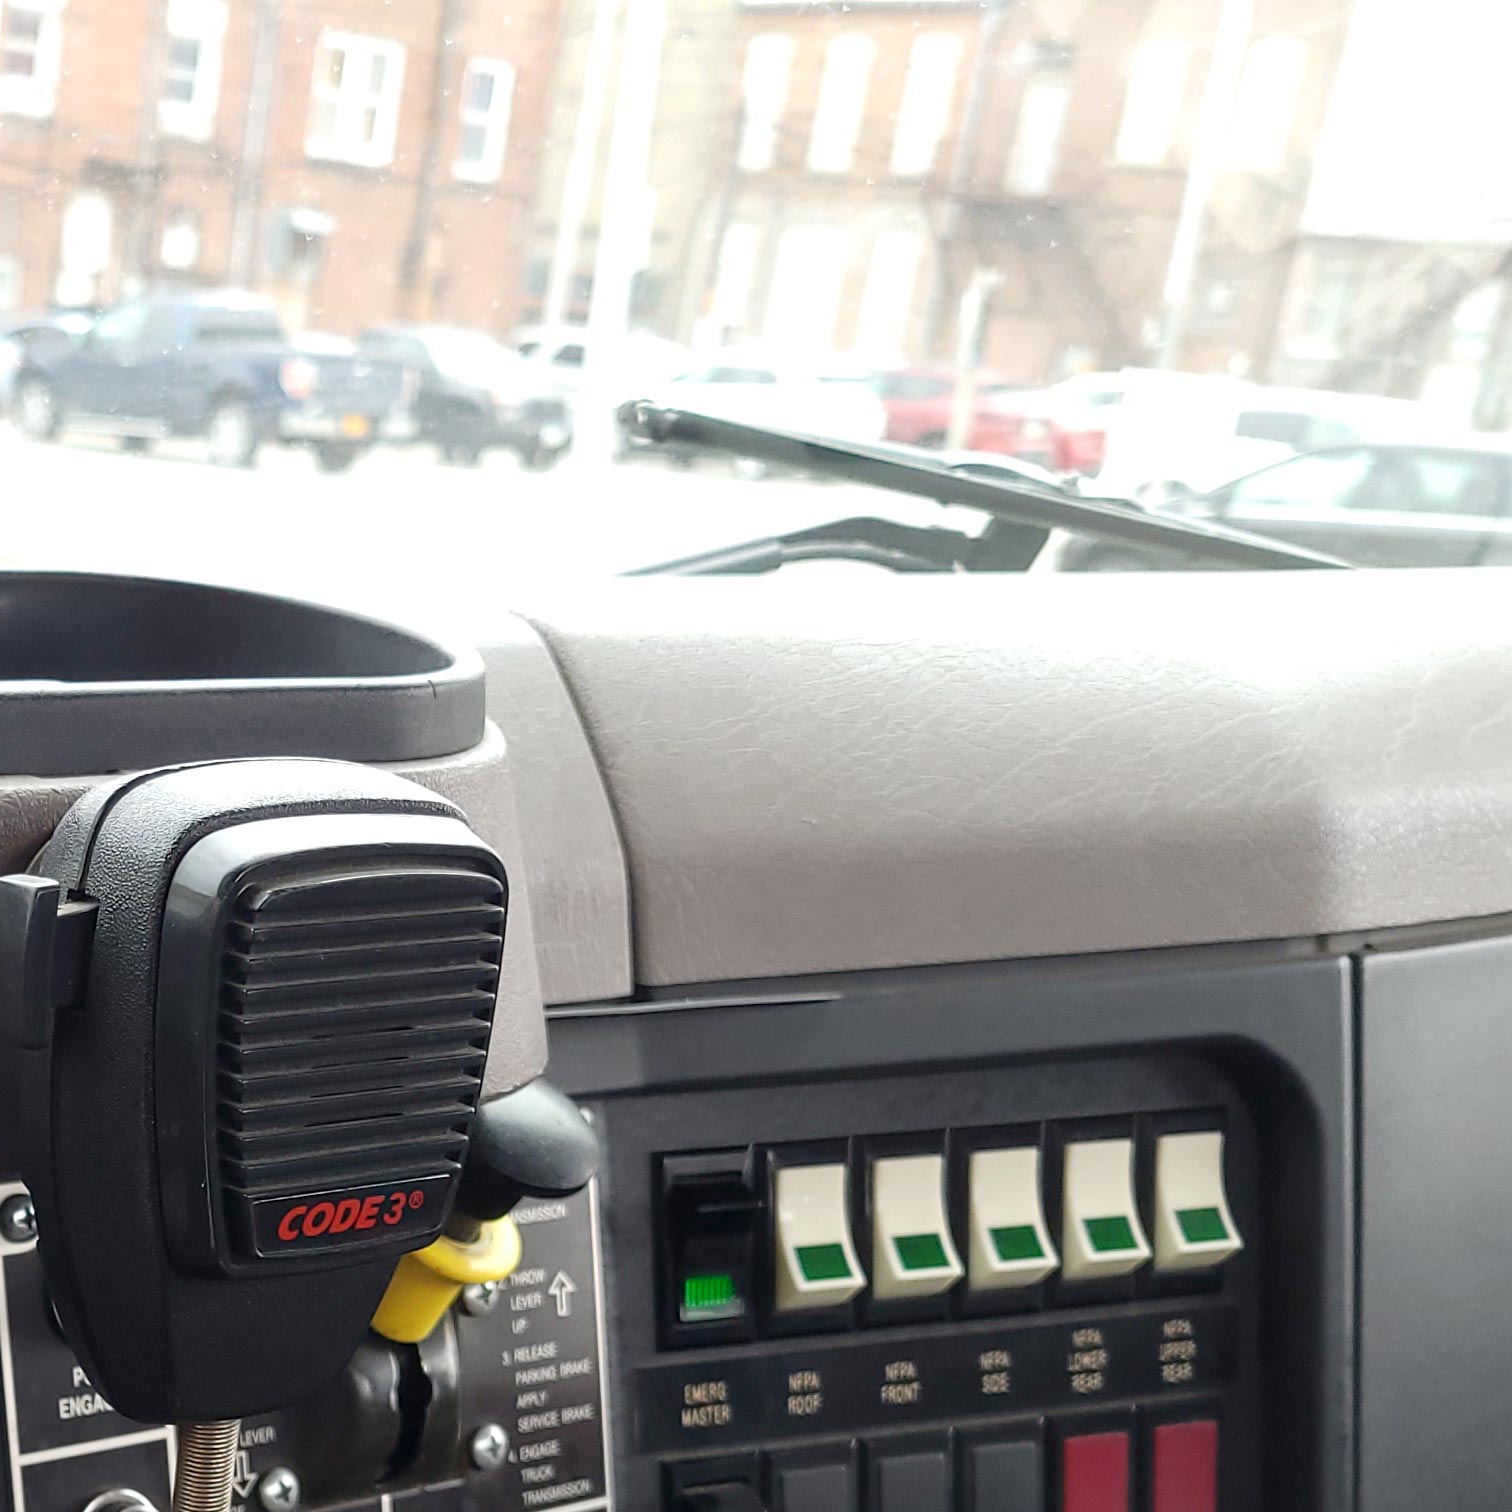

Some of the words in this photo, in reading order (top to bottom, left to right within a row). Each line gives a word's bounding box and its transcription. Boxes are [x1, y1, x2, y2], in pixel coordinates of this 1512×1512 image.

[278, 1195, 385, 1240] CODE
[510, 1291, 542, 1310] LEVER
[516, 1365, 557, 1385] PARKING
[560, 1357, 593, 1378] BRAKE
[789, 1370, 820, 1391] NFPA
[517, 1390, 548, 1409] APPLY
[788, 1394, 822, 1415] ROOF
[881, 1382, 921, 1404] FRONT
[518, 1410, 560, 1433] SERVICE
[561, 1403, 595, 1424] BRAKE
[682, 1403, 730, 1427] MASTER
[522, 1478, 593, 1506] TRANSMISSION
